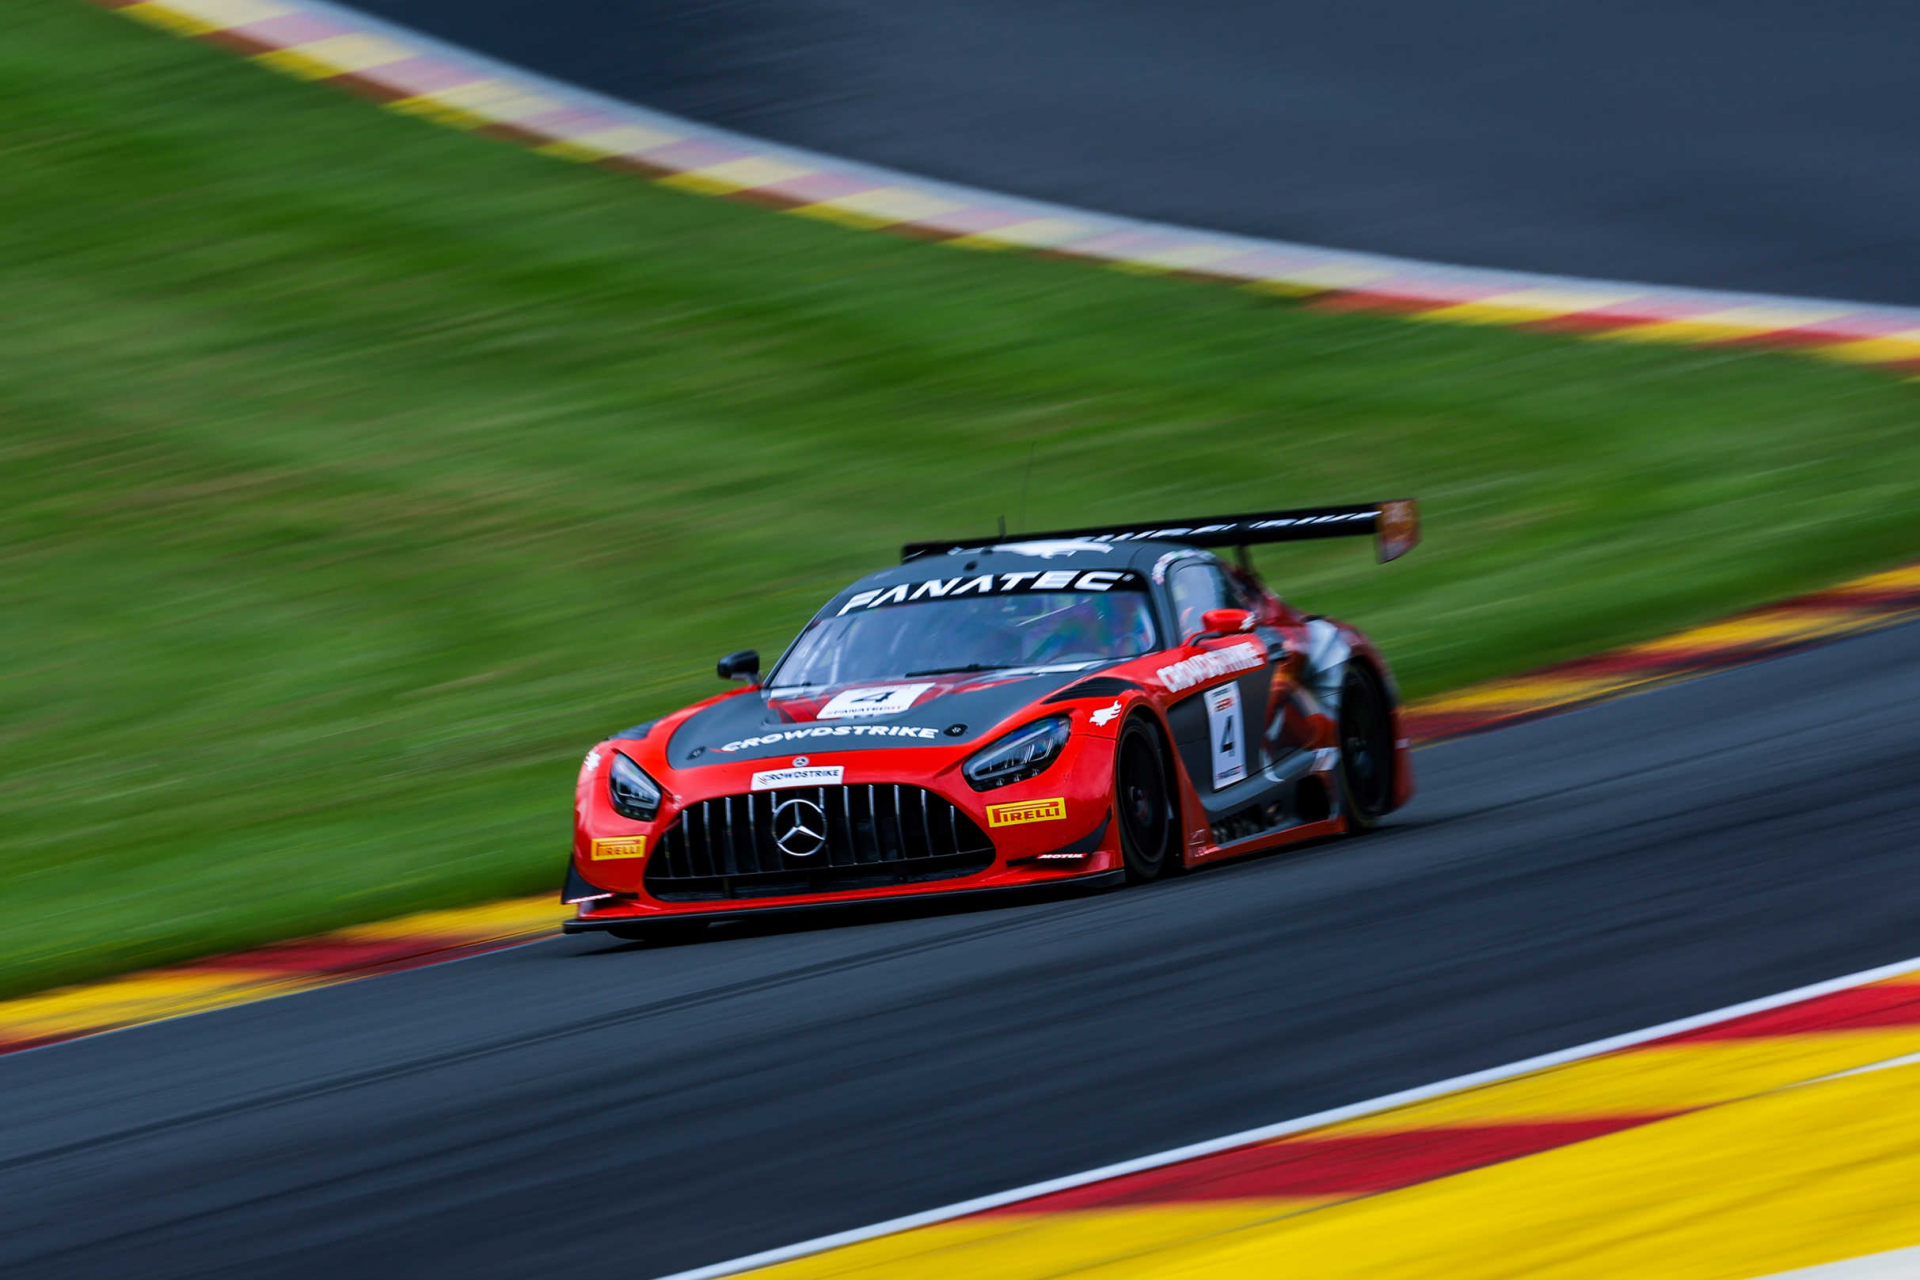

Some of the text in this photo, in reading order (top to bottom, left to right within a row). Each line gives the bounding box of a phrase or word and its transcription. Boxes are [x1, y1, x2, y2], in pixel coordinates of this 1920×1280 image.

[836, 570, 1126, 618] FANATEC
[720, 724, 940, 753] CROWDSTRIKE
[1219, 714, 1236, 758] 4
[992, 801, 1060, 823] PIRELLI
